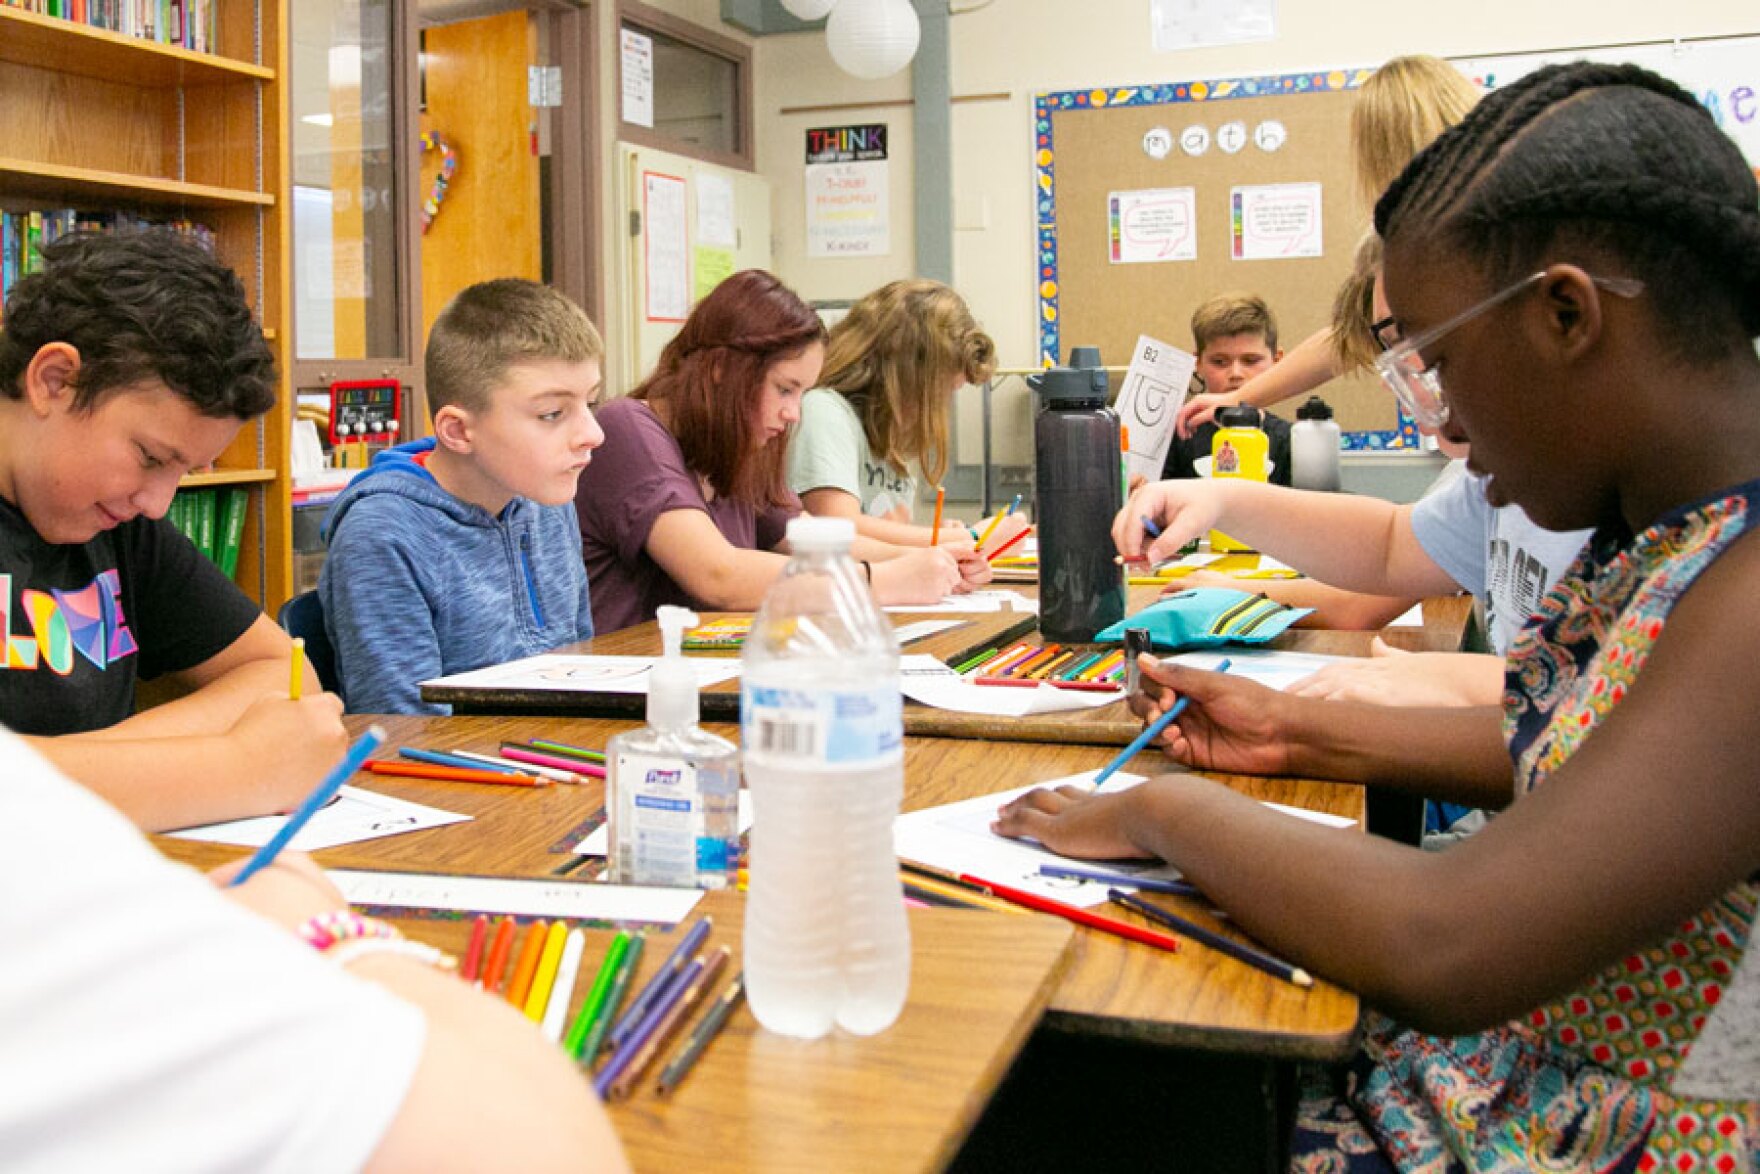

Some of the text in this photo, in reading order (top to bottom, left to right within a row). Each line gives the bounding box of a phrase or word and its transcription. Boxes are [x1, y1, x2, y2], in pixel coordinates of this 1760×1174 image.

[809, 127, 882, 154] THINK
[1145, 122, 1283, 154] math
[0, 568, 139, 677] LOVE
